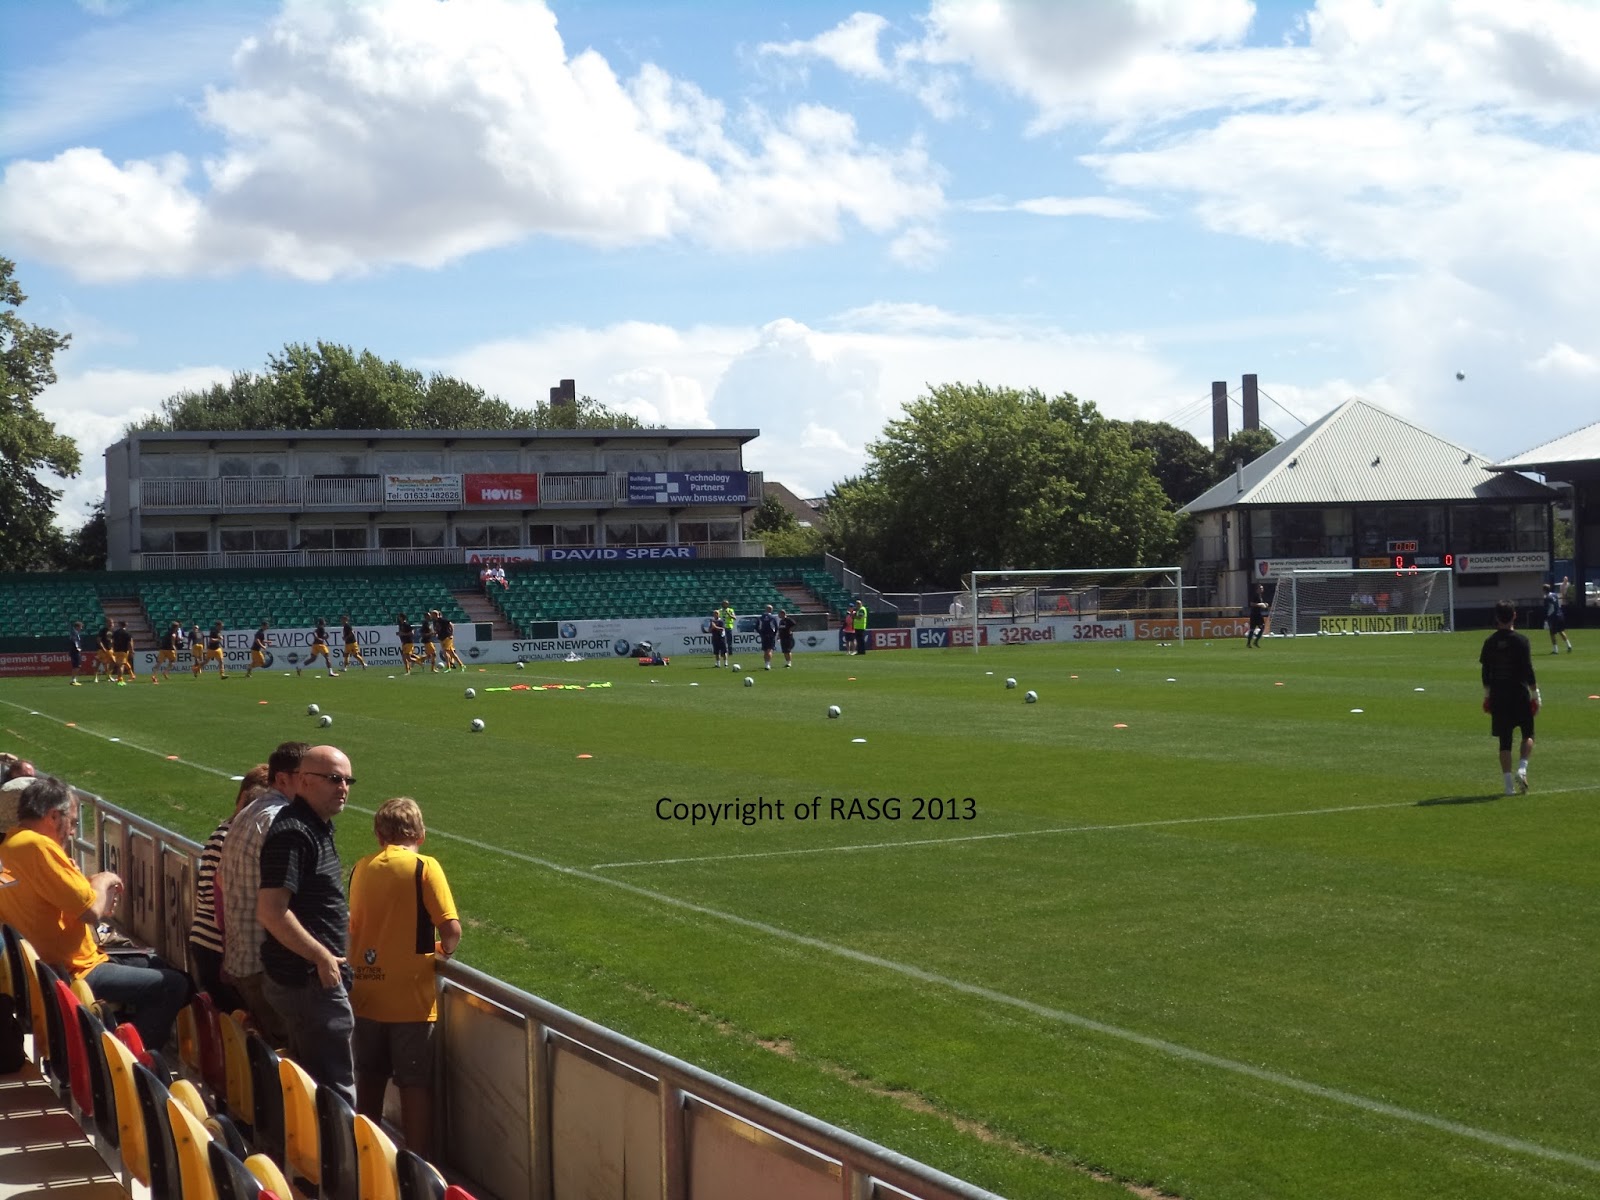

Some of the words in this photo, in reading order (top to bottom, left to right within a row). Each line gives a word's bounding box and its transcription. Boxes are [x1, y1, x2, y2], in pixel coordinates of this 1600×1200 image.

[684, 474, 731, 483] Technology
[387, 492, 402, 500] Tel:
[481, 488, 523, 500] HOVIS
[669, 493, 746, 502] www.bmssw.com
[551, 549, 618, 560] DAVID
[626, 548, 690, 559] SPEAR
[1445, 554, 1453, 566] 0
[1396, 556, 1403, 567] 0
[1138, 623, 1194, 638] Seren
[1201, 620, 1244, 637] Fach
[1321, 618, 1348, 633] BEST
[1352, 617, 1392, 632] BLINDS
[920, 629, 945, 646] sky
[953, 630, 983, 644] BET
[1000, 626, 1052, 641] 32Red
[1073, 624, 1123, 639] 32Red
[512, 642, 555, 652] SYTNER
[557, 639, 610, 650] NEWPORT
[683, 636, 713, 646] SYTN
[731, 634, 762, 644] EWPO
[876, 632, 907, 647] BET
[41, 654, 87, 662] Solutis
[145, 652, 192, 663] SYER
[333, 648, 377, 657] SYER
[357, 966, 381, 974] SYTNER
